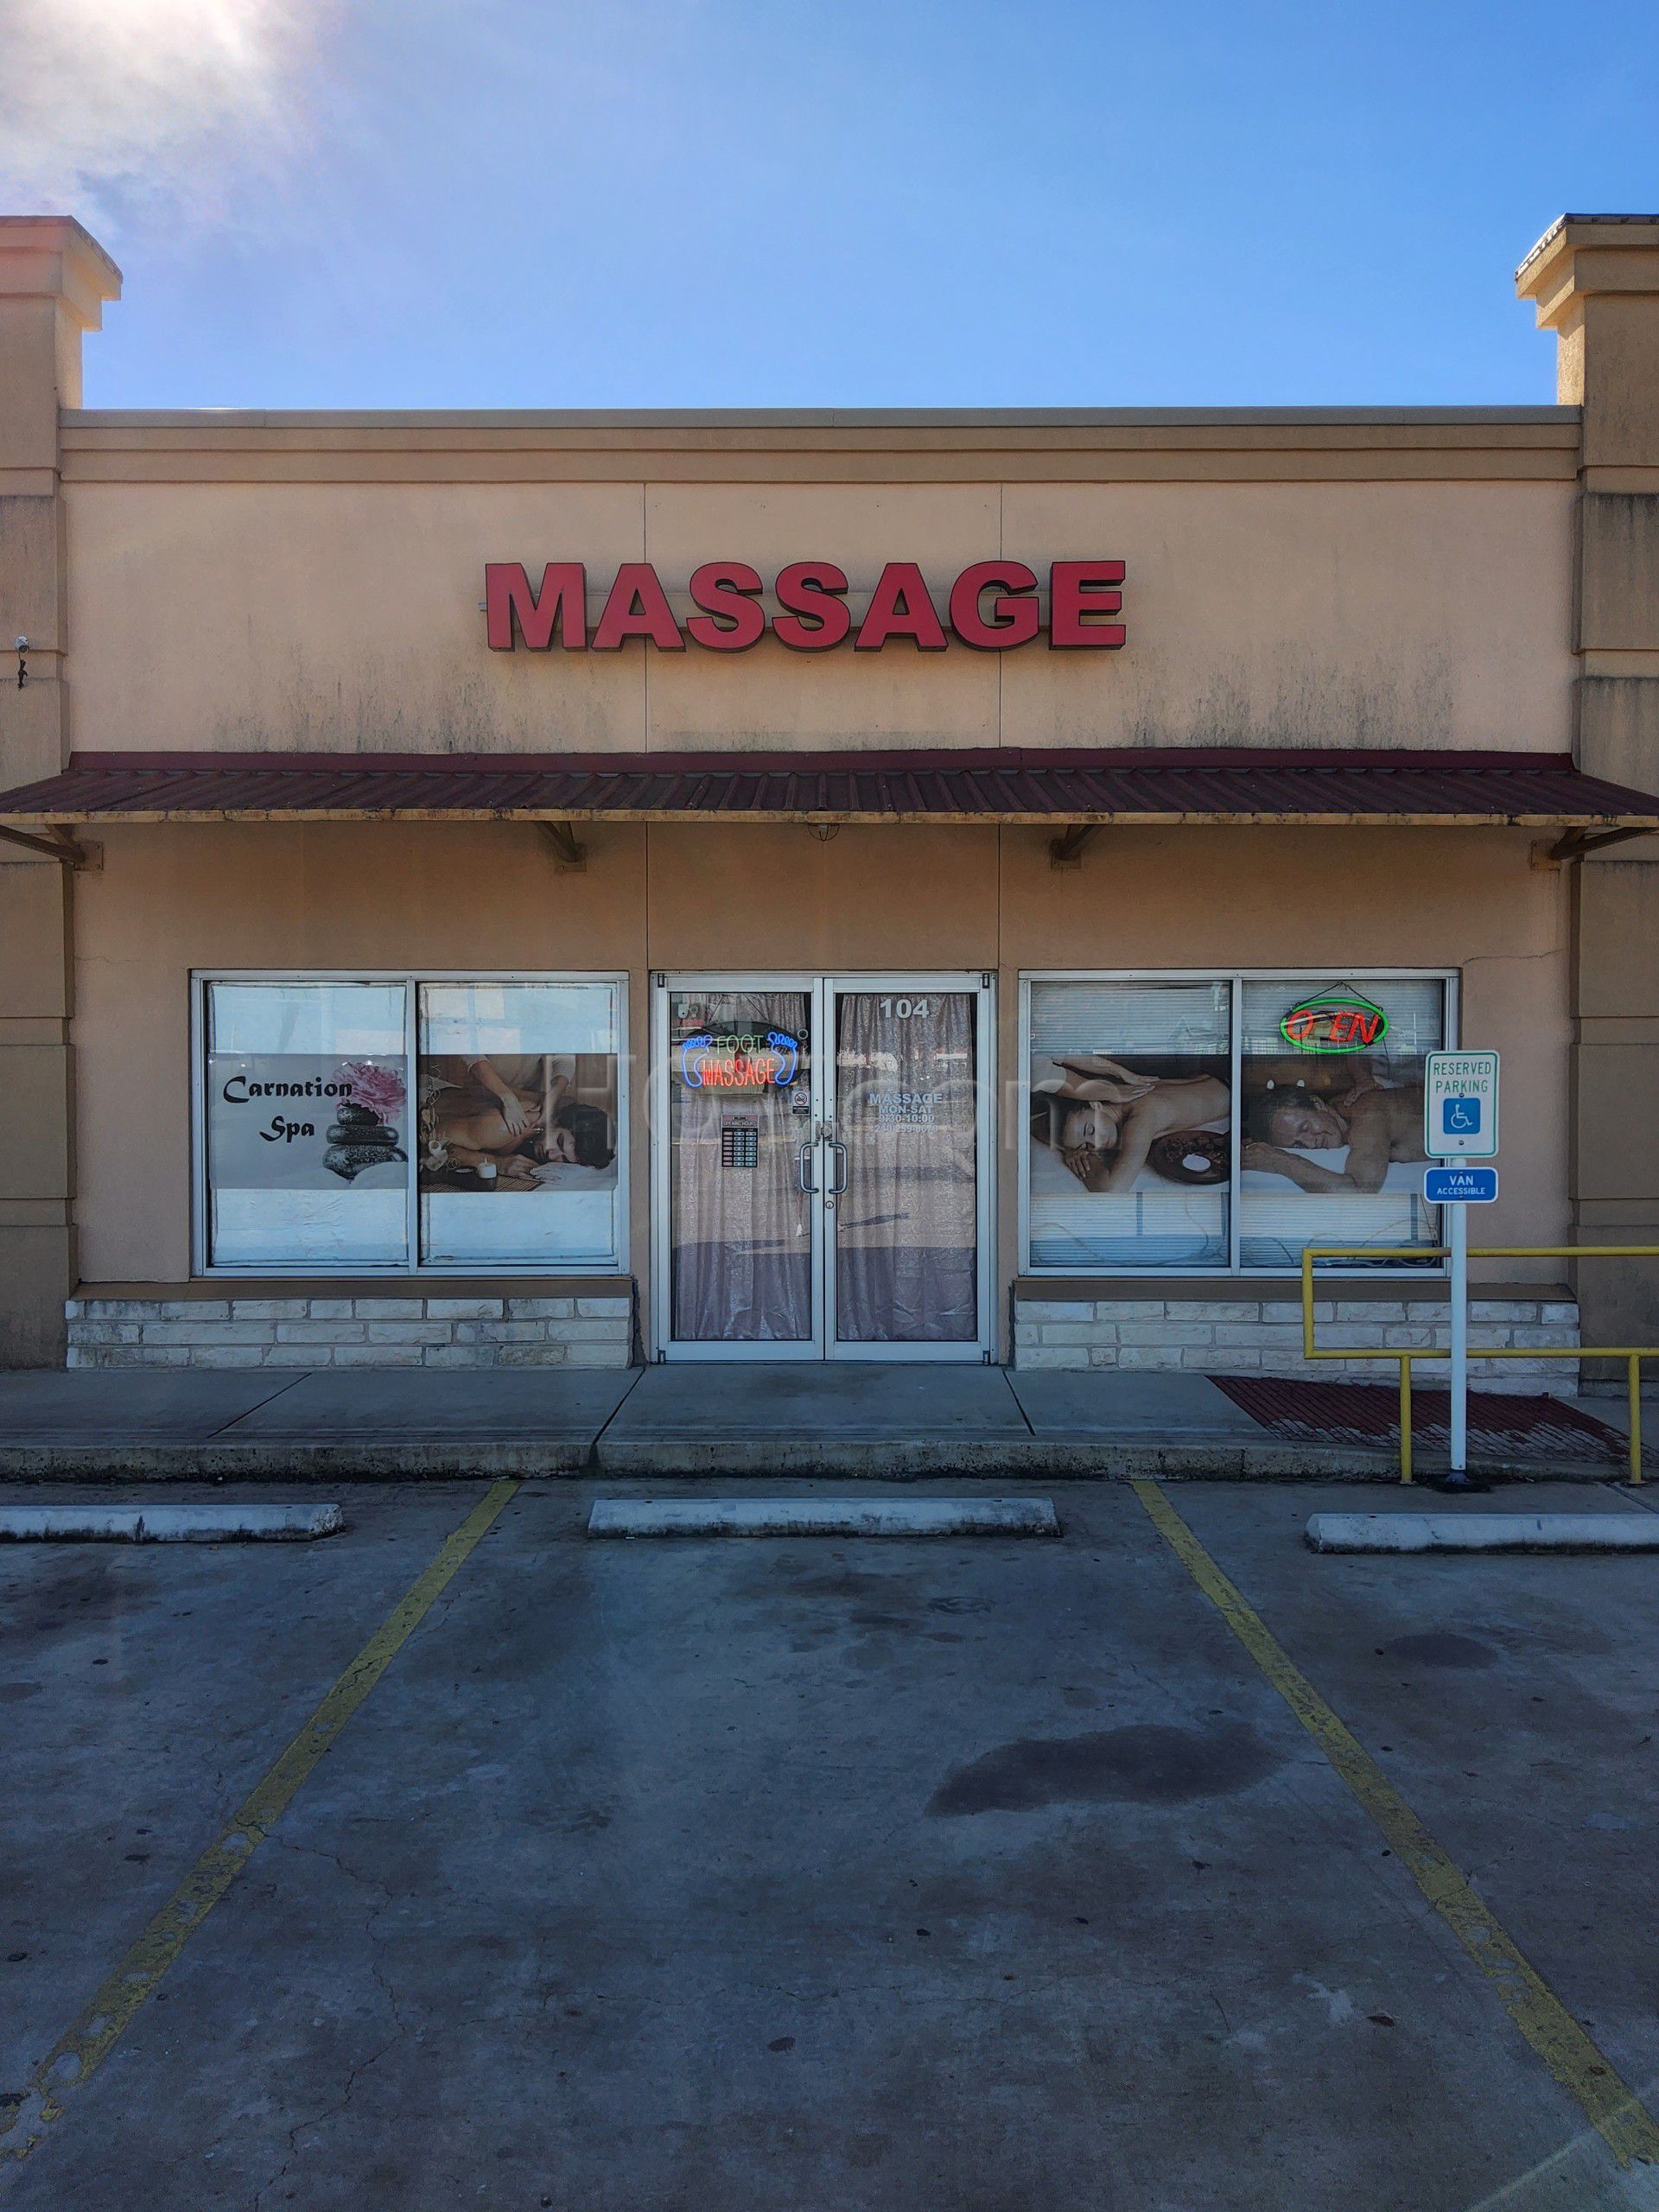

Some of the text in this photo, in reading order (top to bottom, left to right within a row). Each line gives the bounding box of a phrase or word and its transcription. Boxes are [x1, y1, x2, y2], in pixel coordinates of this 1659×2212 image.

[484, 560, 1126, 652] MASSAGE
[880, 998, 930, 1019] 104
[1287, 1009, 1380, 1044] OEN
[716, 1034, 765, 1054] FOOT
[702, 1058, 776, 1087] MASSAGE
[1433, 1062, 1491, 1076] RESERVED
[223, 1076, 353, 1103] Carnation
[1435, 1080, 1488, 1093] PARKING
[869, 1093, 943, 1104] MASSAGE
[879, 1105, 933, 1114] MON-SAT
[259, 1116, 315, 1143] Spa
[1449, 1175, 1474, 1185] VAN
